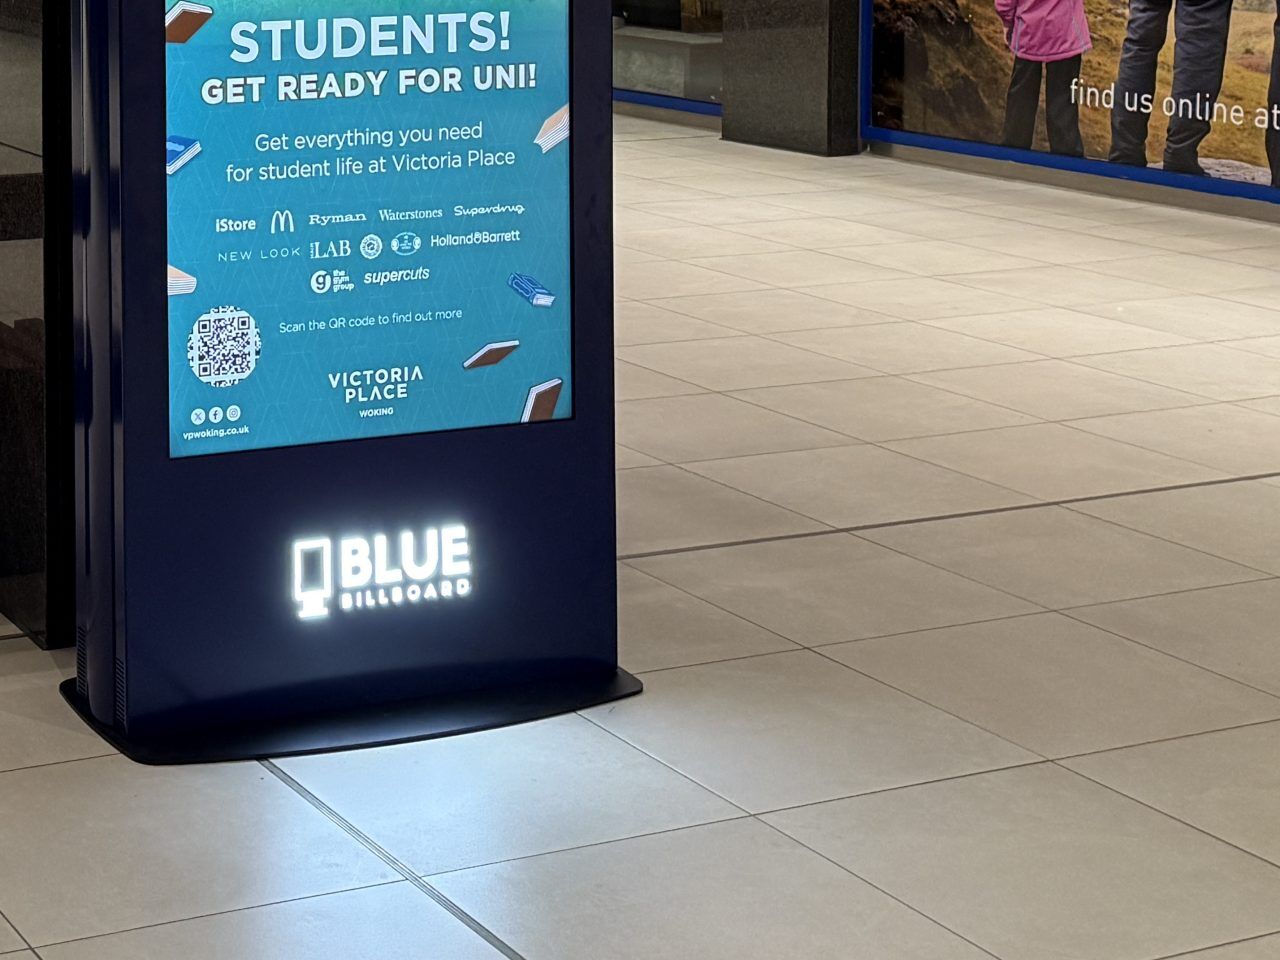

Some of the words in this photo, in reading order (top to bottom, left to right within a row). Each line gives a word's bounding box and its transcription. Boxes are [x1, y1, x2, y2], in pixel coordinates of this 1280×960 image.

[229, 11, 511, 63] STUDENTS!
[201, 76, 266, 105] GET
[278, 70, 388, 101] READY
[398, 67, 462, 95] FOR
[473, 63, 536, 90] UNI!
[1069, 77, 1115, 109] find
[1124, 91, 1153, 114] us
[1162, 92, 1244, 126] online
[1254, 103, 1280, 131] at
[255, 133, 289, 152] Get
[294, 128, 394, 151] everything
[399, 129, 433, 146] you
[438, 121, 483, 141] need
[226, 164, 252, 182] for
[258, 160, 330, 181] student
[336, 157, 363, 175] life
[369, 157, 387, 173] at
[392, 151, 462, 172] Victoria
[468, 149, 516, 167] Place
[215, 218, 257, 233] iStore
[308, 213, 367, 226] Ryman
[379, 209, 443, 222] Waterstones
[453, 203, 526, 217] Superdrug
[218, 251, 253, 262] NEW
[260, 247, 301, 259] LOOK
[315, 240, 351, 259] LAB
[333, 283, 355, 293] group
[363, 266, 431, 285] supercuts
[279, 322, 306, 334] Scan
[308, 320, 326, 331] the
[328, 317, 346, 329] QR
[348, 315, 376, 328] code
[378, 314, 390, 325] to
[392, 312, 412, 323] find
[414, 310, 433, 322] out
[435, 308, 463, 320] more
[328, 365, 424, 389] VICTORIA
[345, 383, 408, 404] PLACE
[359, 407, 394, 419] WOKING
[182, 424, 250, 441] vpwoking.co.uk
[340, 524, 470, 588] BLUE
[340, 579, 470, 610] BILLBOARD
